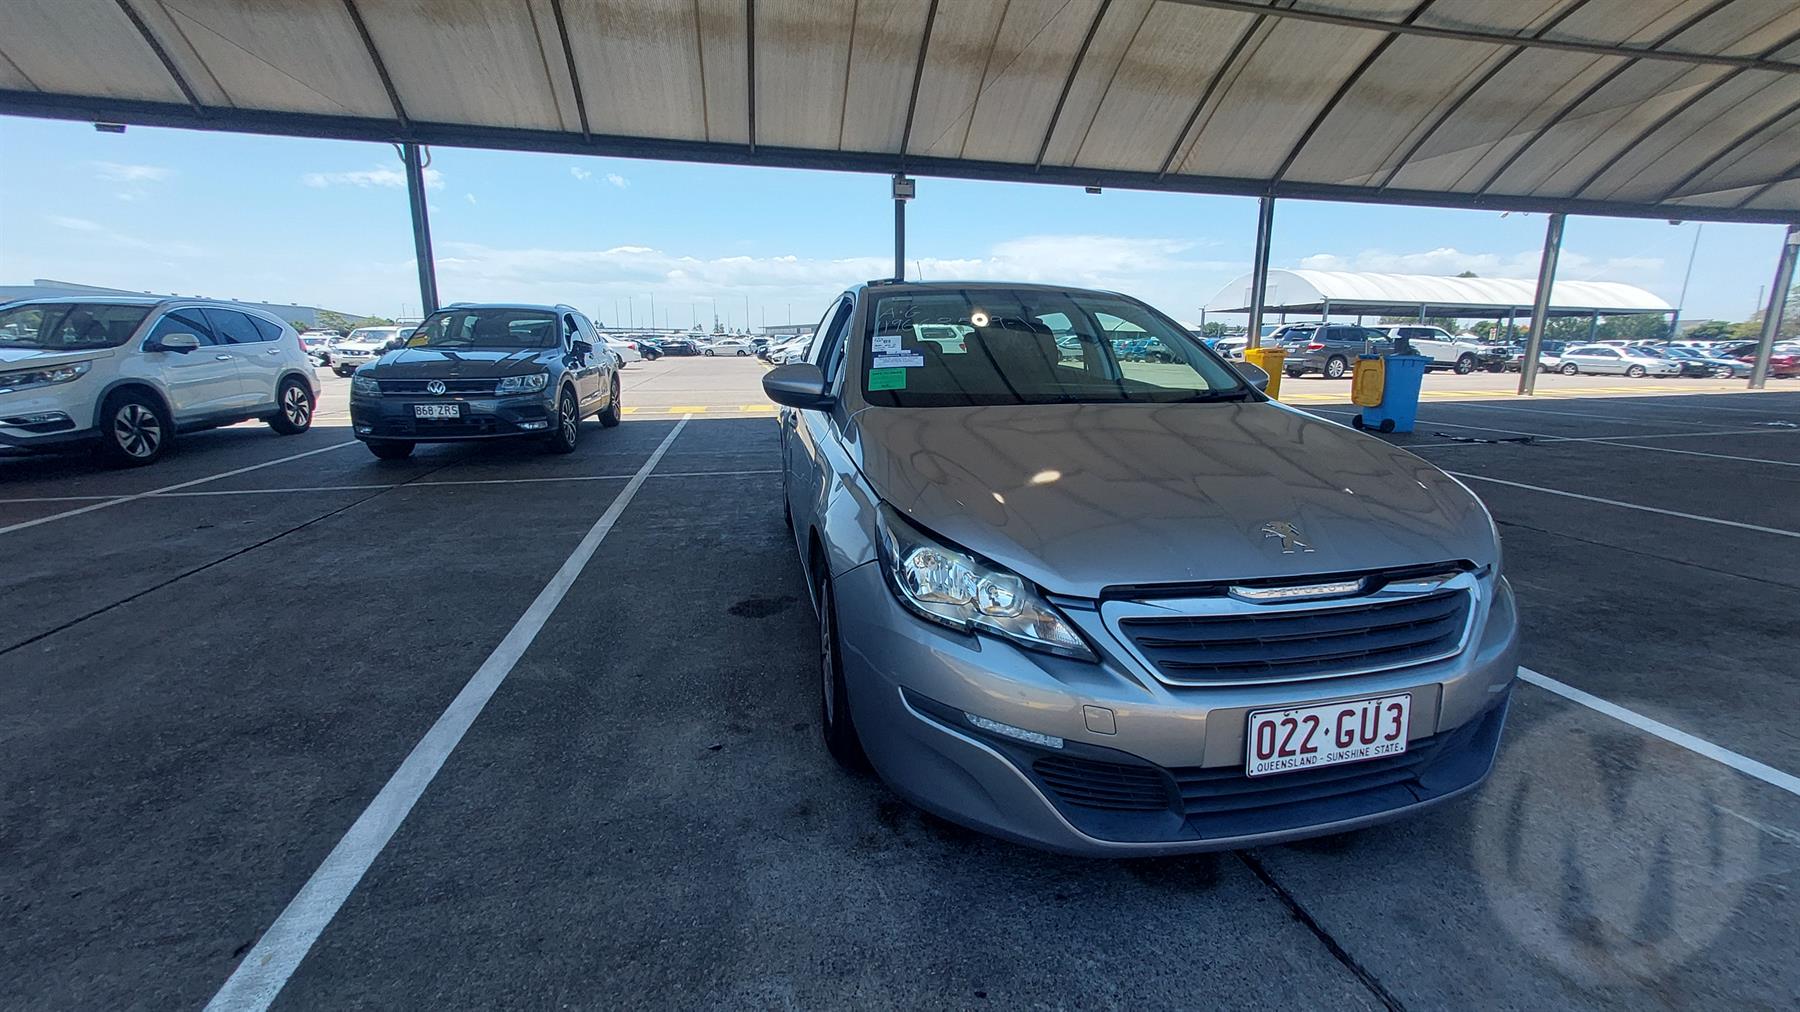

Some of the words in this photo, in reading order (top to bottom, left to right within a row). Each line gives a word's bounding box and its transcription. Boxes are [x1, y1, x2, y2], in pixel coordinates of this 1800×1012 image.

[1256, 754, 1319, 773] QUEENSLAND
[1326, 746, 1370, 763] SUNSHINE
[1374, 742, 1400, 755] STATE
